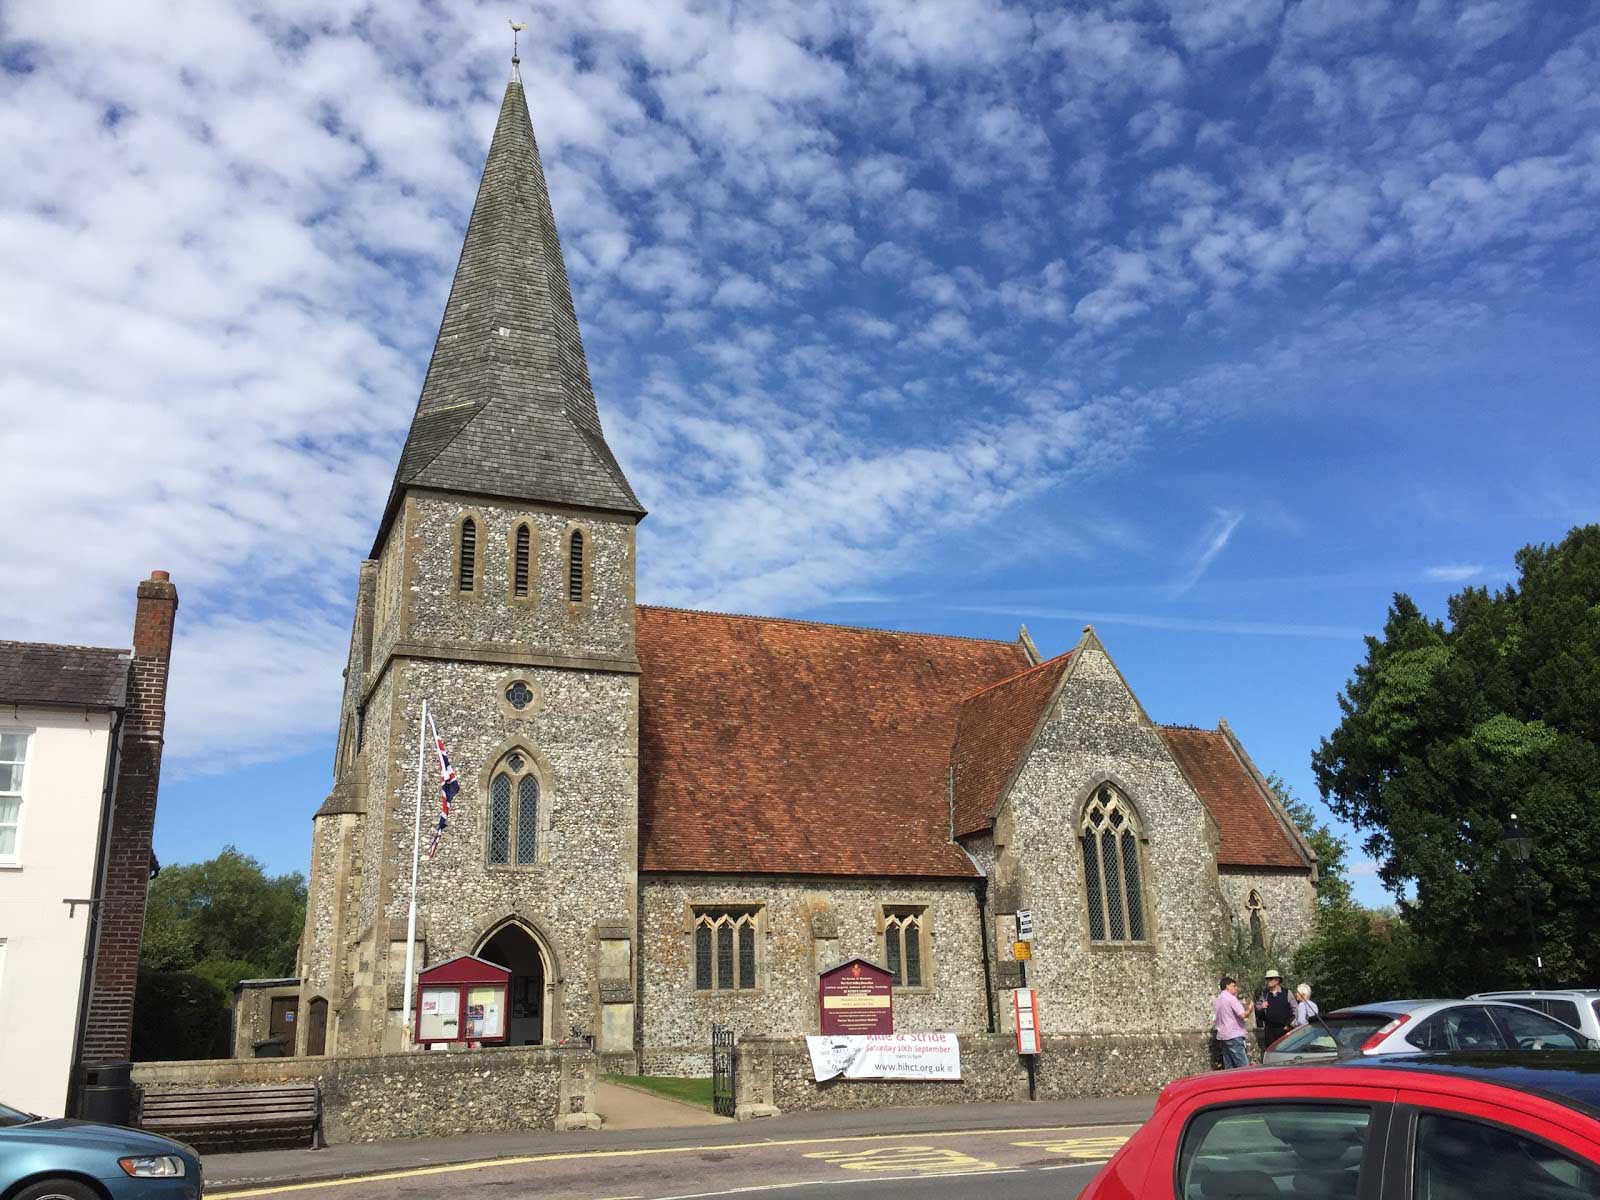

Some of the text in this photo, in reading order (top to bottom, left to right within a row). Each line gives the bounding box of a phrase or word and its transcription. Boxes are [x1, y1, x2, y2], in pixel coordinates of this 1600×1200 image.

[866, 1045, 896, 1053] Saturday
[914, 1045, 951, 1054] September
[874, 1062, 945, 1074] www.hihct.org.uk
